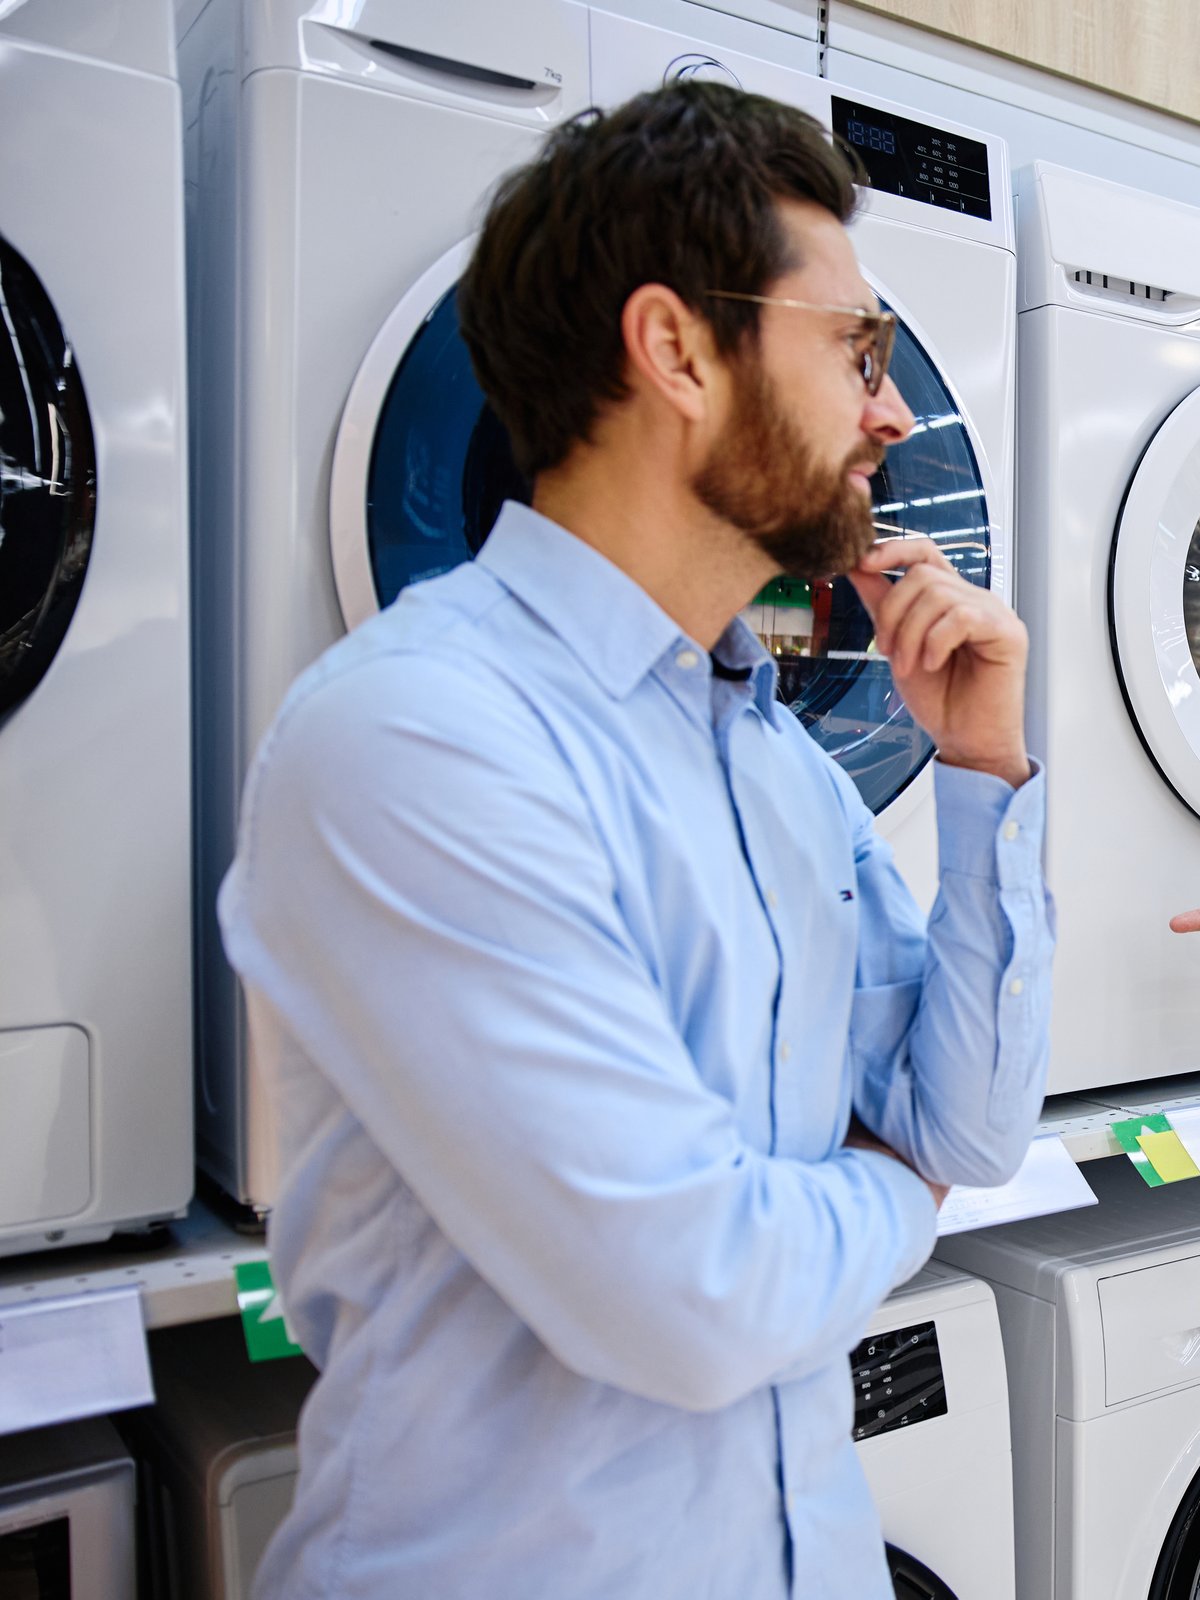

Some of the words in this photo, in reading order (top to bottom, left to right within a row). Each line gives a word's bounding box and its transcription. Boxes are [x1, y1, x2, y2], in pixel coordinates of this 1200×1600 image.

[544, 66, 562, 83] 7kg
[933, 166, 943, 174] 400
[948, 170, 958, 178] 600
[920, 172, 929, 181] 800
[933, 177, 944, 185] 1000
[948, 181, 959, 190] 1200
